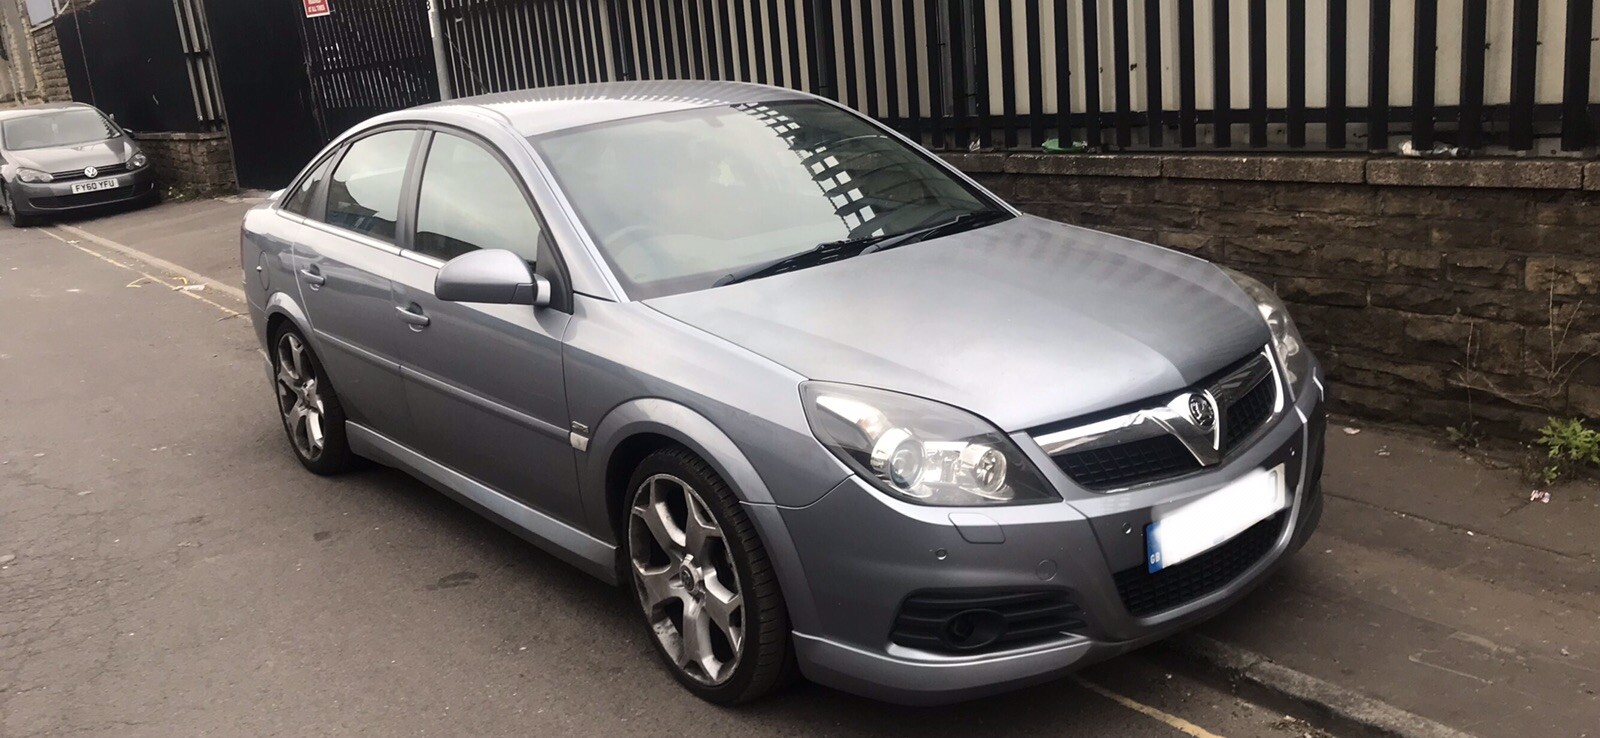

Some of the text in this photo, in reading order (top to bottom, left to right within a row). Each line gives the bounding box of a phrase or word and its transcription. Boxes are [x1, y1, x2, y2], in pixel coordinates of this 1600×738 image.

[75, 180, 115, 192] FY60 YFU
[1150, 552, 1160, 564] GB
